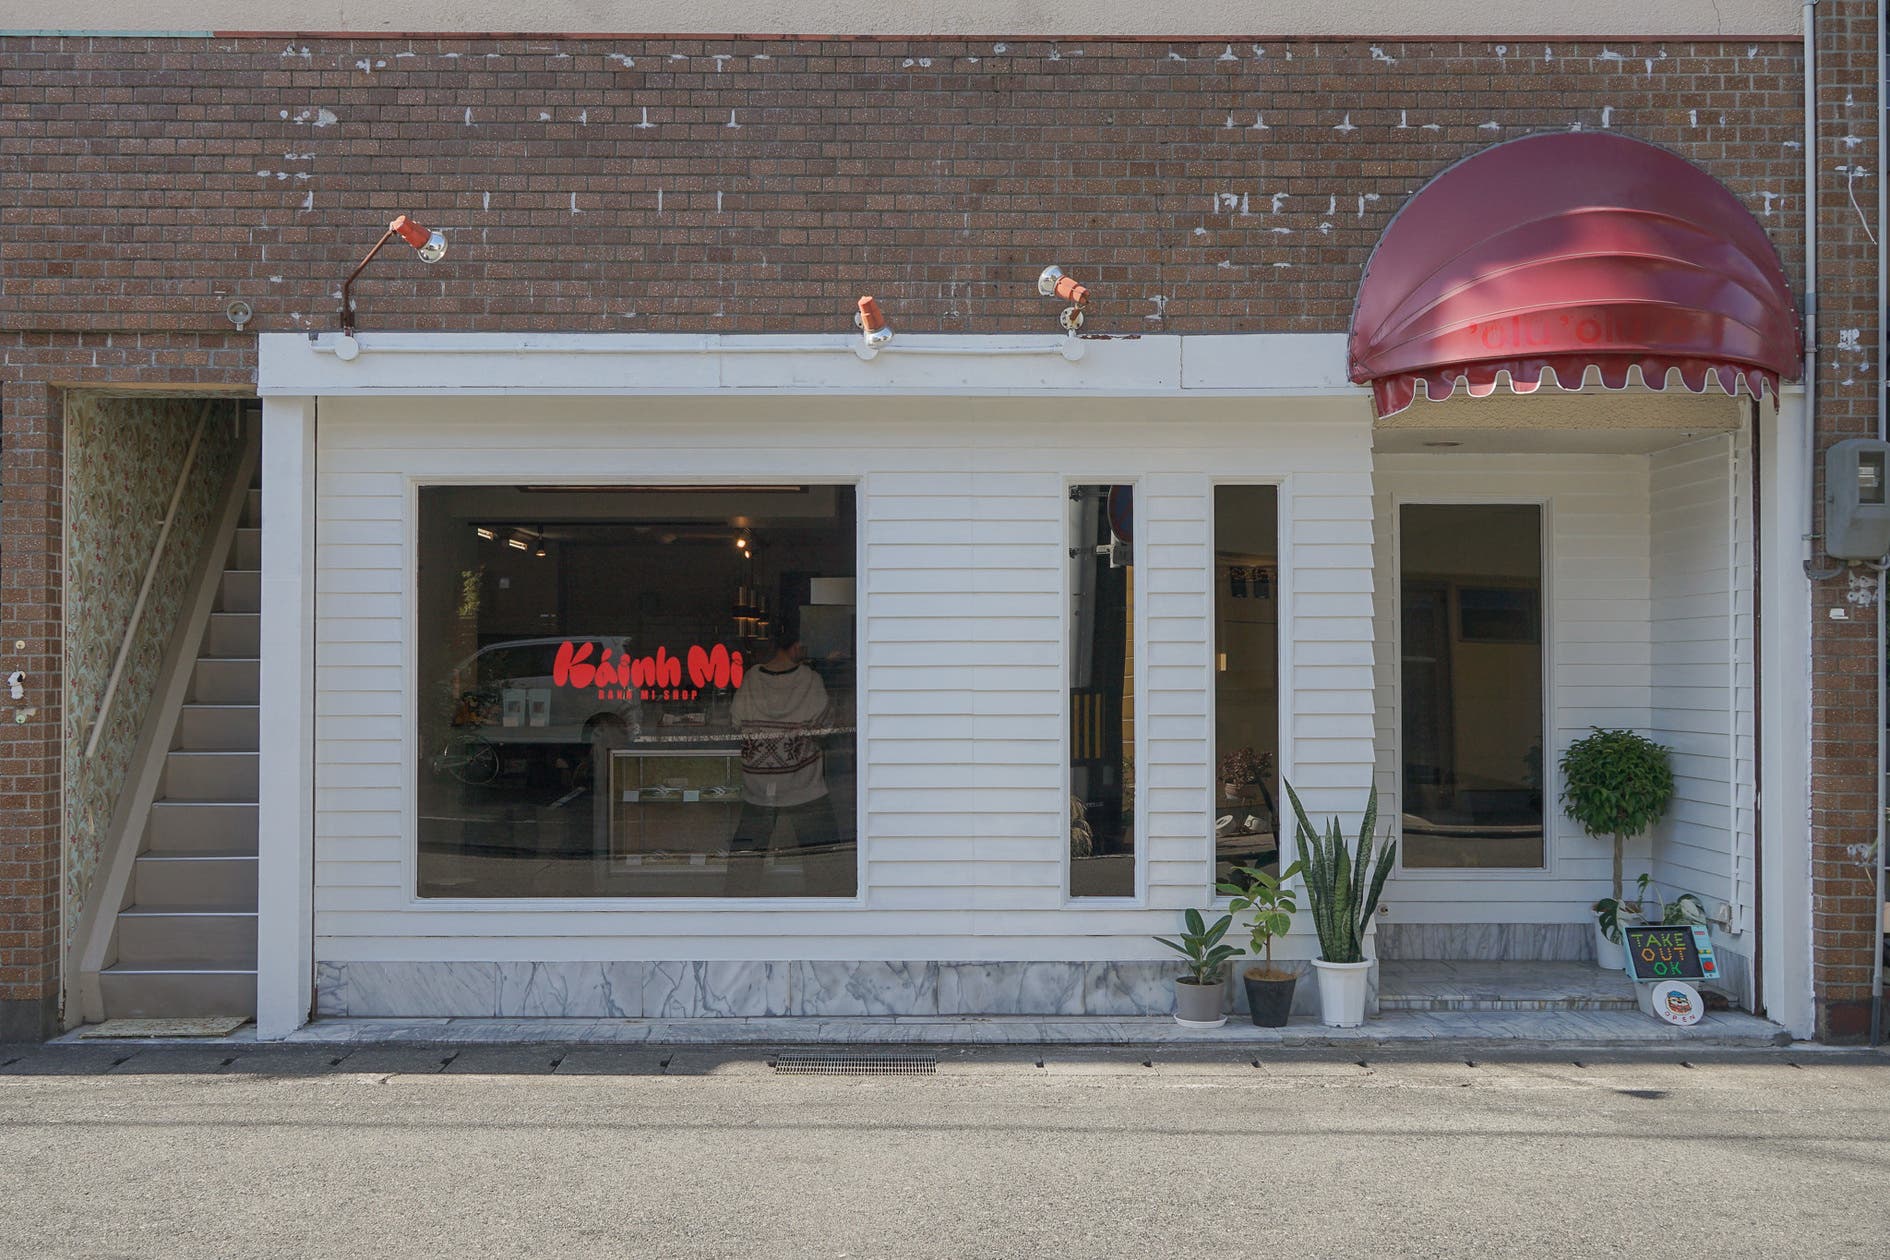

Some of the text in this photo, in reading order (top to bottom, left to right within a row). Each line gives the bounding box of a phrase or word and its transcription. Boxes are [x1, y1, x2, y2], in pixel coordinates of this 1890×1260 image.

[688, 643, 744, 688] Mi
[641, 689, 656, 700] MI
[663, 689, 697, 700] SHOP
[1631, 933, 1687, 947] TAKE
[1641, 947, 1687, 962] OUT
[1654, 961, 1682, 975] OK
[1665, 1011, 1696, 1022] OPEN
